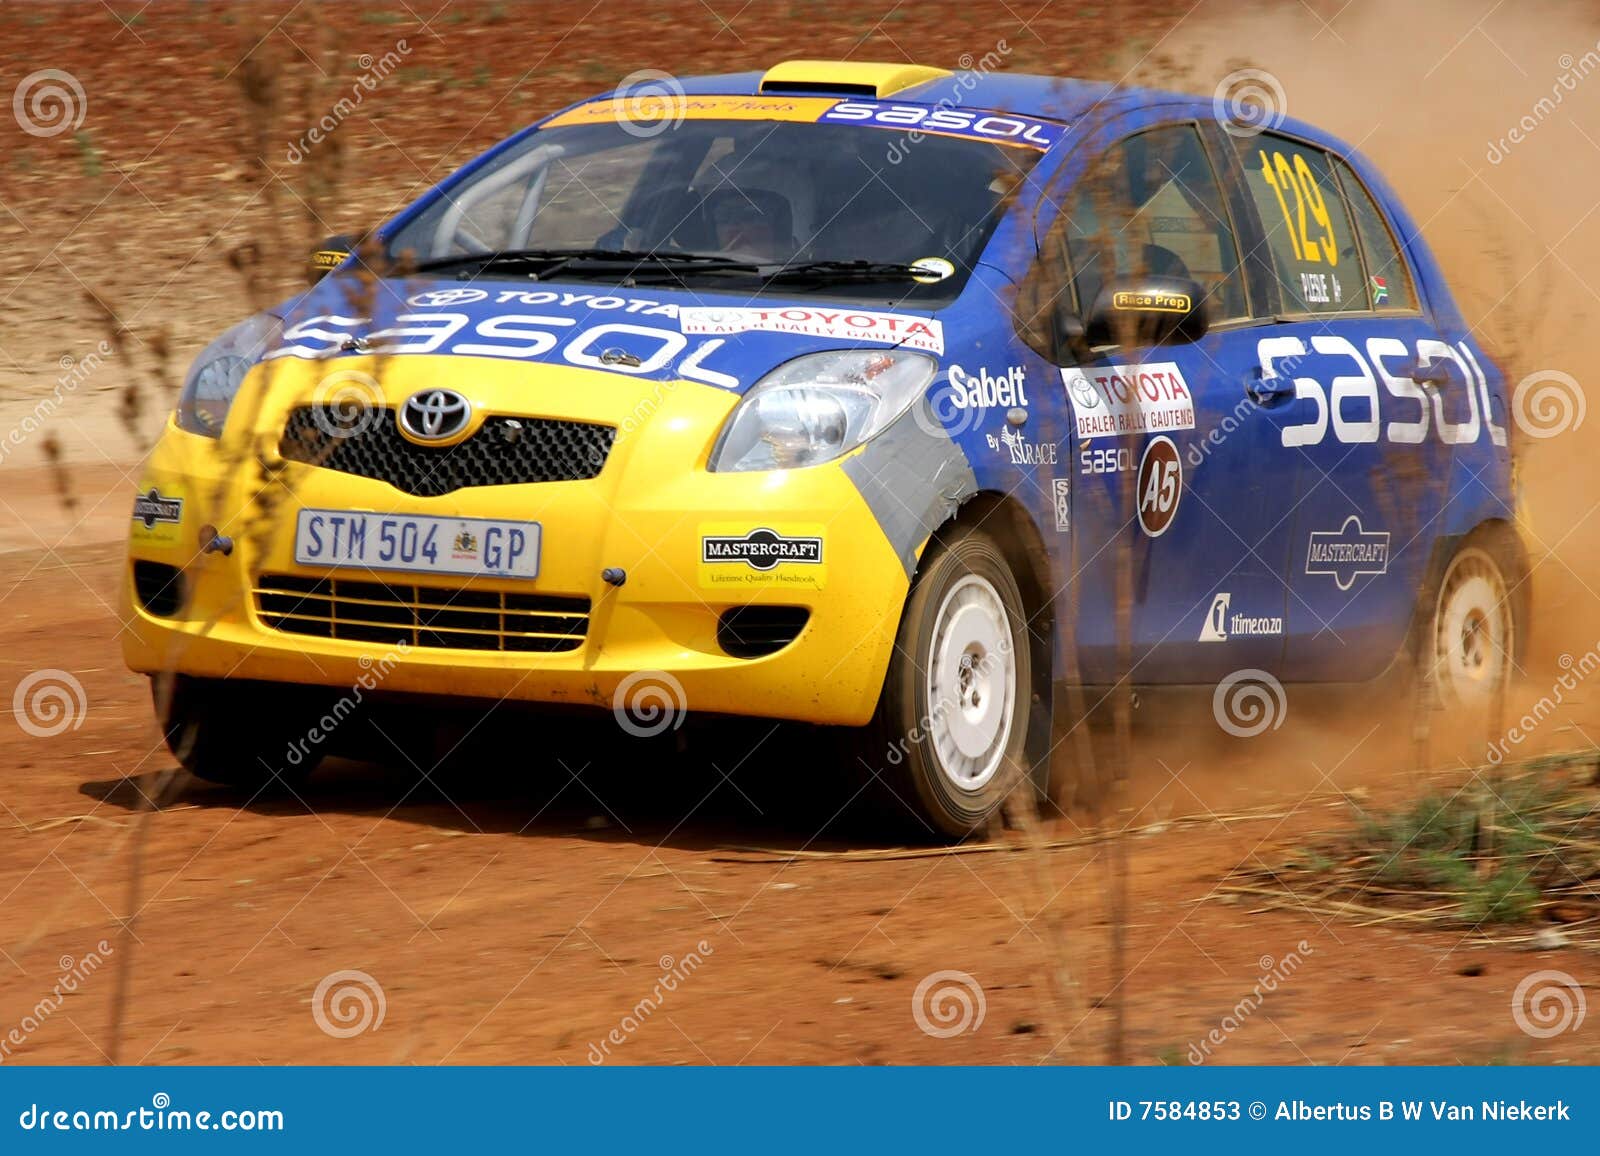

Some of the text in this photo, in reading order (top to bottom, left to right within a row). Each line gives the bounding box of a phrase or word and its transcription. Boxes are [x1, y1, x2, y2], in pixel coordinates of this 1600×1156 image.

[1259, 150, 1337, 266] 129
[495, 291, 680, 319] TOYOTA
[1120, 295, 1185, 309] Race Prep
[751, 311, 935, 338] TOYOTA
[948, 365, 1028, 409] Sabelt
[1097, 372, 1189, 405] TOYOTA
[1080, 408, 1193, 434] DEALER RALLY GAUTENG
[985, 433, 1000, 452] By
[1142, 461, 1178, 513] A5
[306, 516, 526, 569] STM 504 GP
[708, 543, 817, 557] MASTERCRAFT
[1311, 542, 1387, 563] MASTERCRAFT
[745, 574, 773, 584] Quality
[1231, 613, 1282, 635] 1time.co.za
